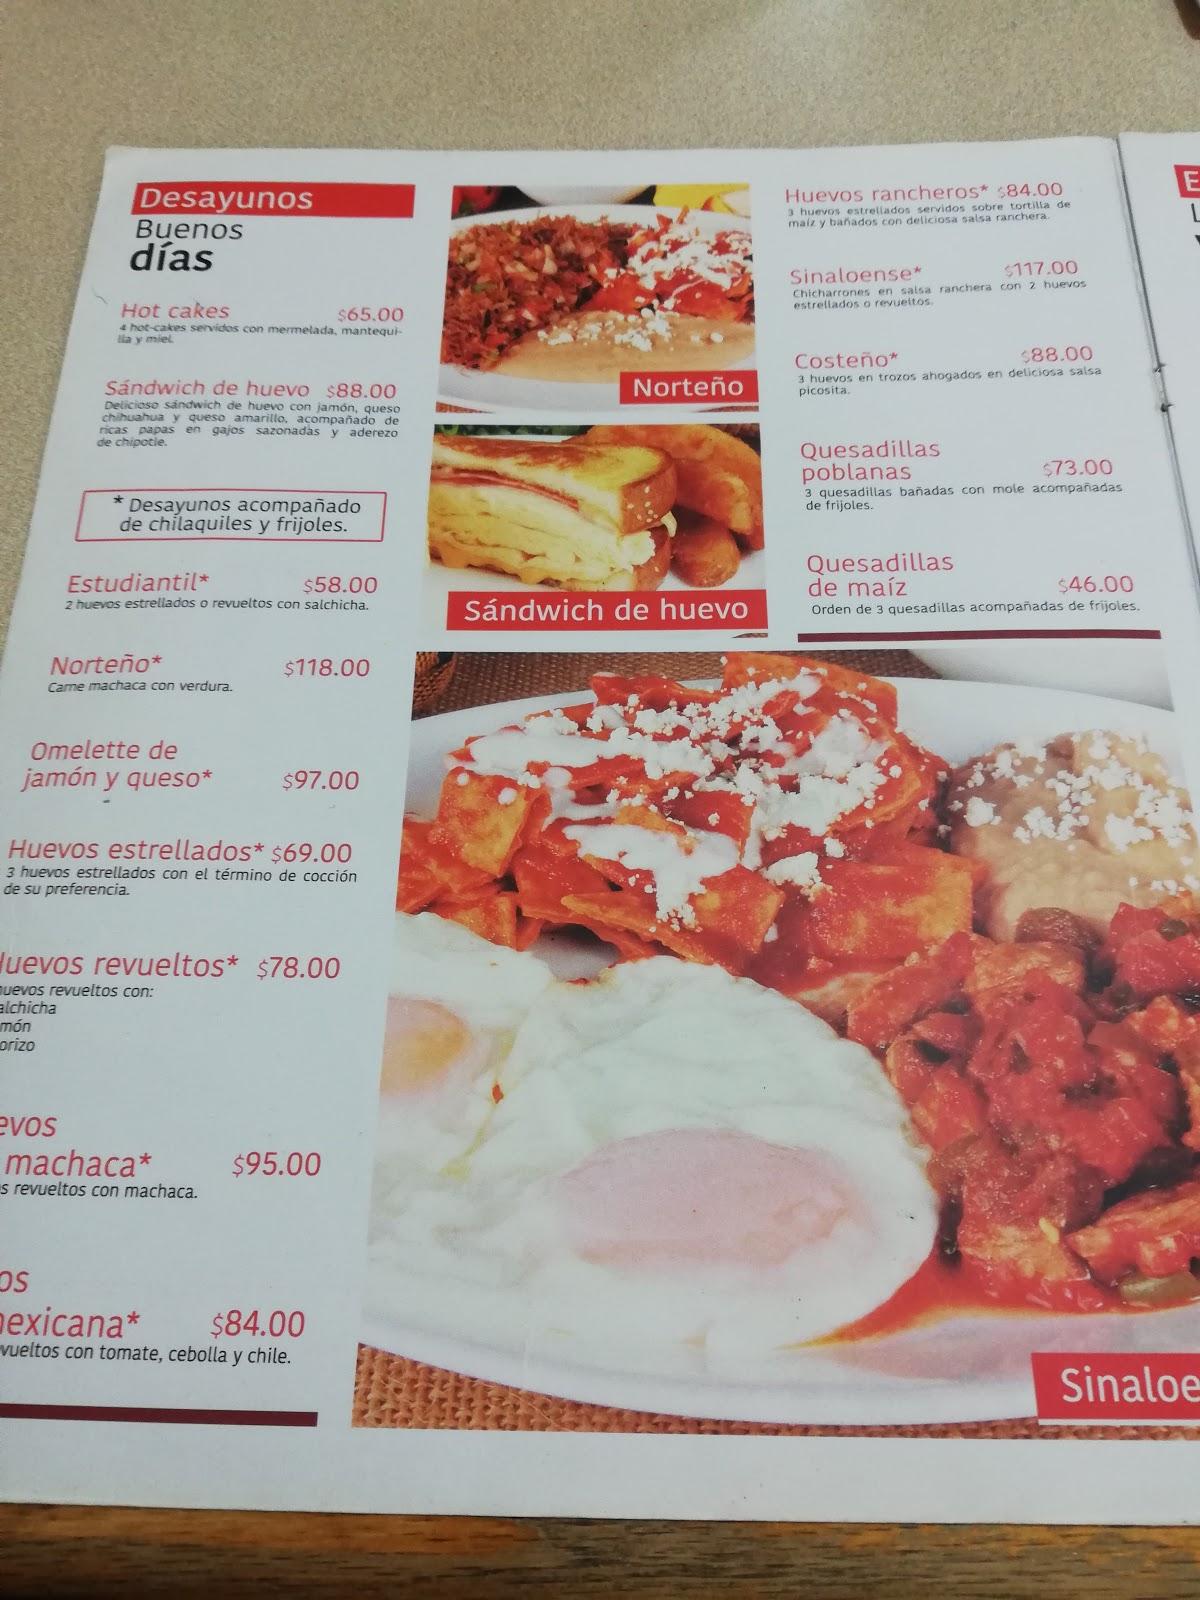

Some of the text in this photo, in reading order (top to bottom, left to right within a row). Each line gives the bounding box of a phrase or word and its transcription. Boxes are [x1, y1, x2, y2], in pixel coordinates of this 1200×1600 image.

[140, 187, 314, 213] Desayunos
[785, 187, 863, 204] Huevos
[997, 181, 1064, 199] $84.00
[135, 219, 243, 240] Buenos
[129, 242, 214, 272] días
[1004, 260, 1078, 278] $117.00
[120, 303, 404, 323] Hot cakes $65.00
[1021, 345, 1094, 364] $88.00
[810, 365, 1102, 384] huevos trozos ahogados deliciosa salsa
[104, 379, 397, 400] Sándwich de huevo $88.00
[633, 377, 744, 397] Norteño
[799, 386, 851, 398] picosita.
[800, 439, 941, 460] Quesadillas
[802, 459, 1113, 485] poblanas $73.00
[819, 483, 1123, 499] quesadillas bañadas con mole acompañadas
[129, 497, 362, 515] Desayunos acompañado
[806, 499, 873, 512] de frijoles.
[119, 515, 348, 536] de chilaquiles y frijoles.
[806, 552, 954, 575] Quesadillas
[303, 575, 379, 595] $58.00
[808, 575, 1134, 598] de maíz $46.00
[76, 597, 369, 611] huevos estrellados revueltos con salchicha.
[463, 598, 748, 622] Sándwich de huevo
[811, 600, 1141, 616] Orden de quesadillas acompañadas de frijoles.
[283, 658, 371, 678] $118.00
[88, 680, 146, 692] machaca
[151, 681, 175, 691] con
[179, 680, 233, 692] verdura.
[30, 740, 178, 761] Omelette de
[20, 766, 97, 792] jamón
[103, 771, 119, 791] y
[282, 770, 359, 791] $97.00
[8, 839, 99, 860] Huevos
[271, 842, 352, 864] $69.00
[20, 866, 357, 882] huevos estrellados con el término de cocción
[3, 882, 130, 898] de su preferencia.
[256, 956, 340, 980] $78.00
[49, 983, 118, 998] revueltos
[122, 985, 154, 998] con:
[232, 1151, 322, 1178] $95.00
[14, 1181, 86, 1197] revueltos
[91, 1183, 119, 1198] con
[124, 1182, 199, 1199] machaca.
[211, 1309, 305, 1339] $84.00
[65, 1346, 94, 1359] con
[99, 1345, 163, 1363] tomate,
[168, 1345, 227, 1362] cebolla
[232, 1350, 245, 1366] y
[248, 1347, 291, 1364] chile.
